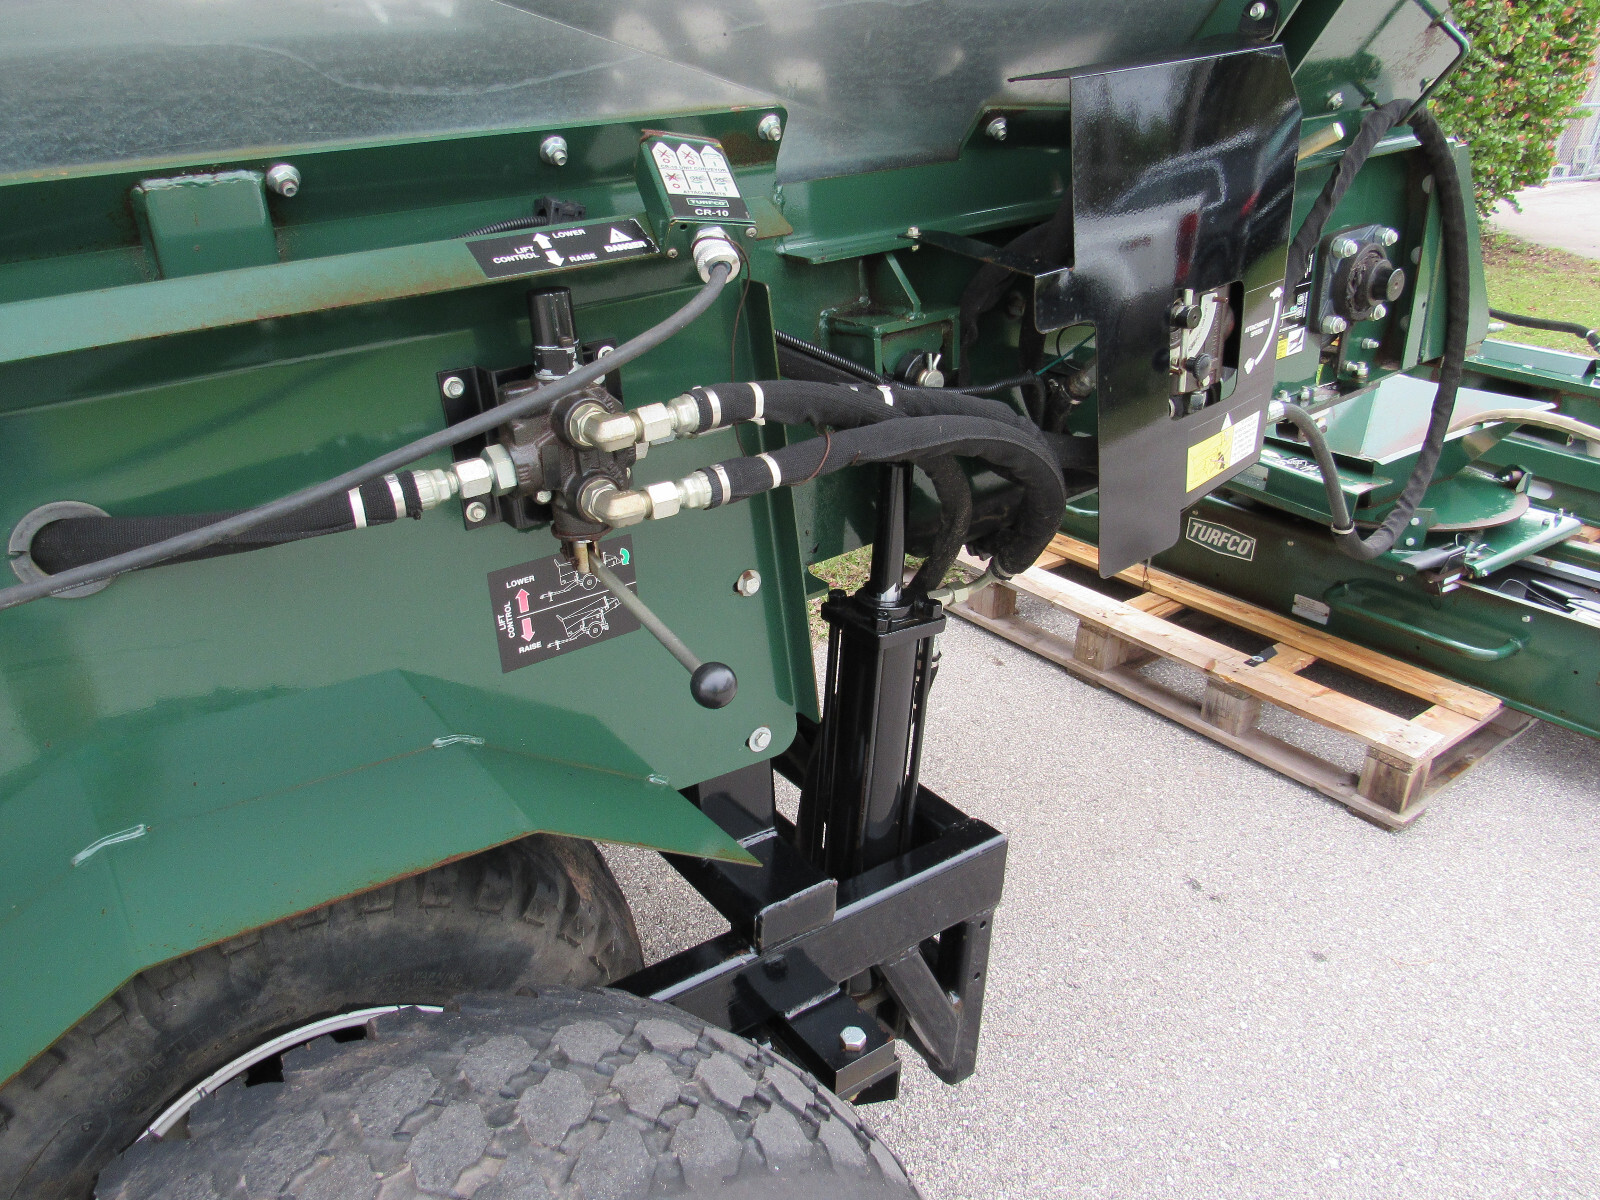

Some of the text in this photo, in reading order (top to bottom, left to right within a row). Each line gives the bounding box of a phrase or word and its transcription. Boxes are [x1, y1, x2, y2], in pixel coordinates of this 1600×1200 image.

[694, 208, 729, 217] CR-10
[551, 228, 586, 239] LOWER
[513, 245, 535, 255] LIFT
[603, 240, 647, 253] DANGER
[492, 252, 540, 264] CONTROL
[568, 252, 598, 263] RAISE
[1245, 317, 1271, 334] ATTACHMENT
[1250, 327, 1264, 338] SPEED
[1190, 521, 1251, 555] TURFCO
[505, 575, 535, 589] LOWER
[497, 614, 506, 631] LIFT
[503, 601, 516, 639] CONTROL
[518, 641, 542, 654] RAISE
